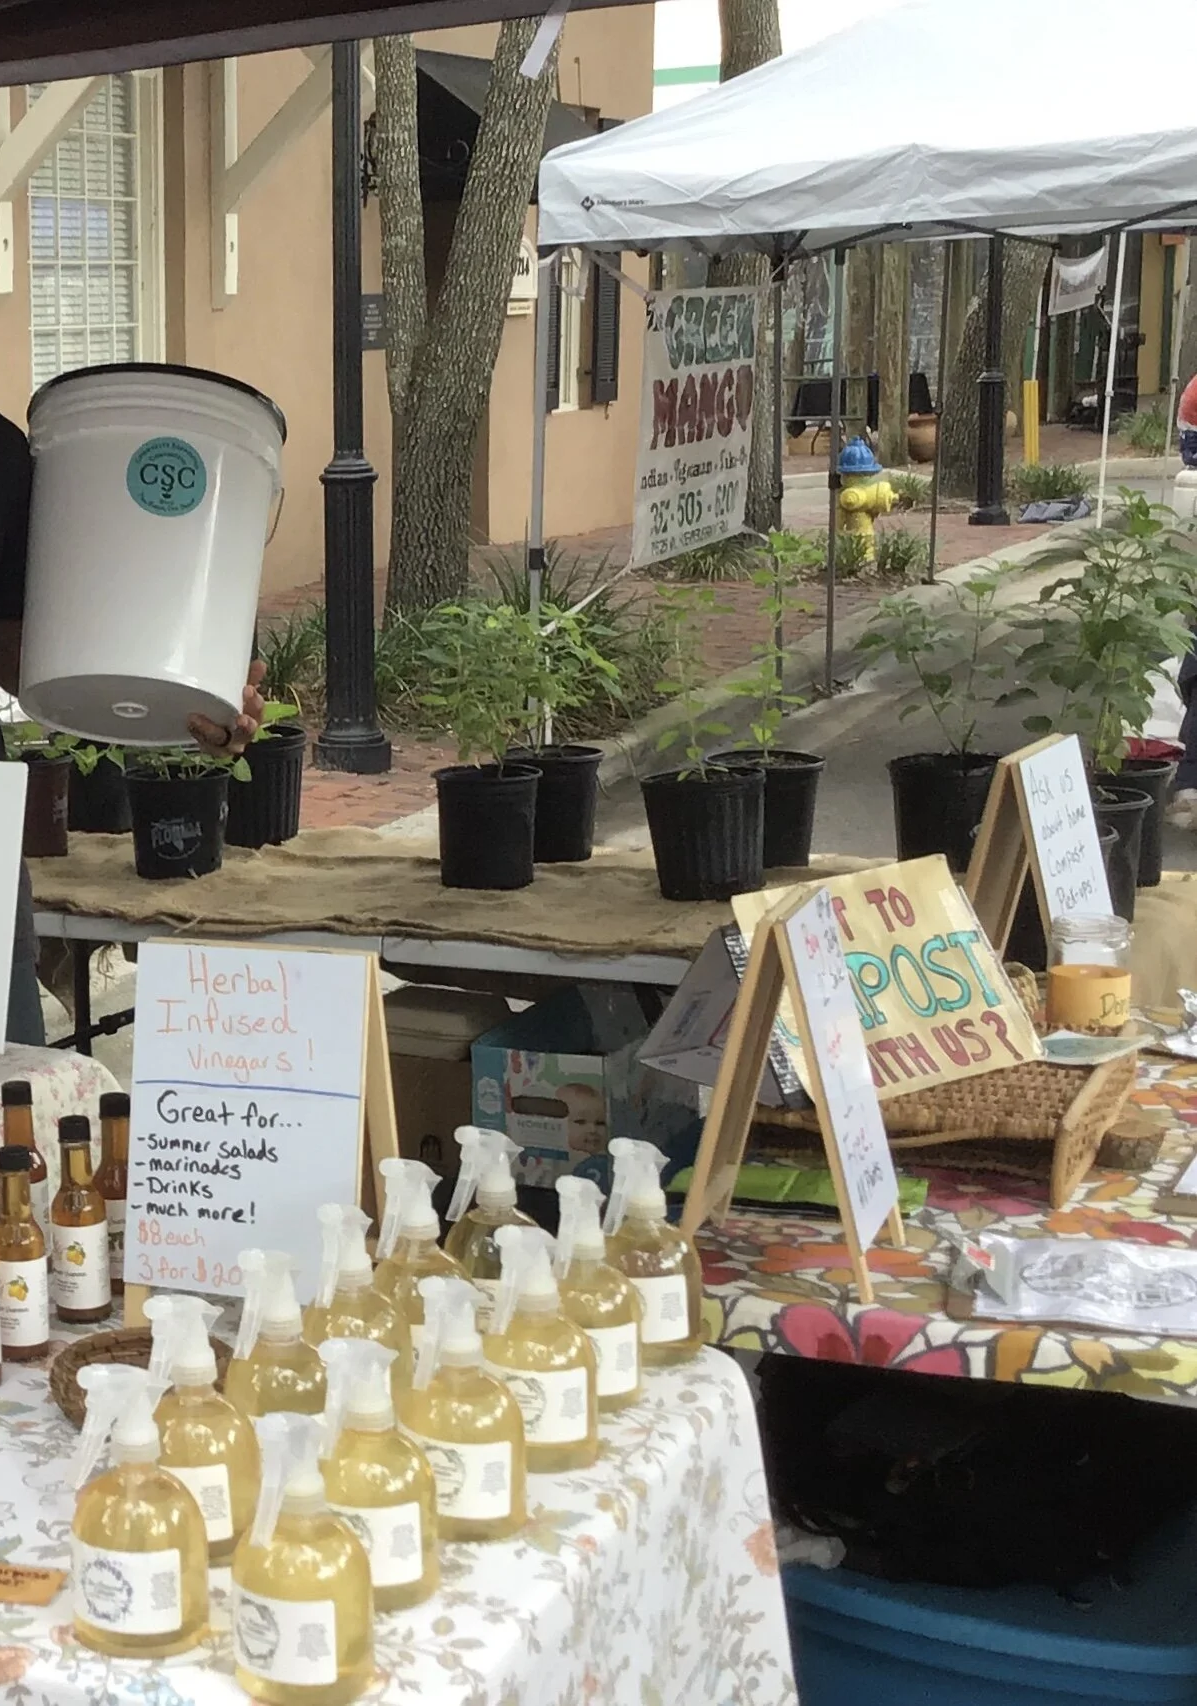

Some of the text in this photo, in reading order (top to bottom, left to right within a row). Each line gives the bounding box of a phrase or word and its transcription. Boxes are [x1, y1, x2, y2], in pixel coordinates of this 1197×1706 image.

[651, 364, 753, 450] MANGO
[139, 463, 196, 489] CSC
[1029, 764, 1055, 807] Ask
[864, 886, 915, 933] TO
[189, 950, 290, 1000] Herbal
[844, 930, 1001, 1030] POST
[156, 998, 298, 1036] Infused
[156, 1090, 235, 1126] Great
[137, 1253, 153, 1281] 3
[158, 1256, 189, 1279] for
